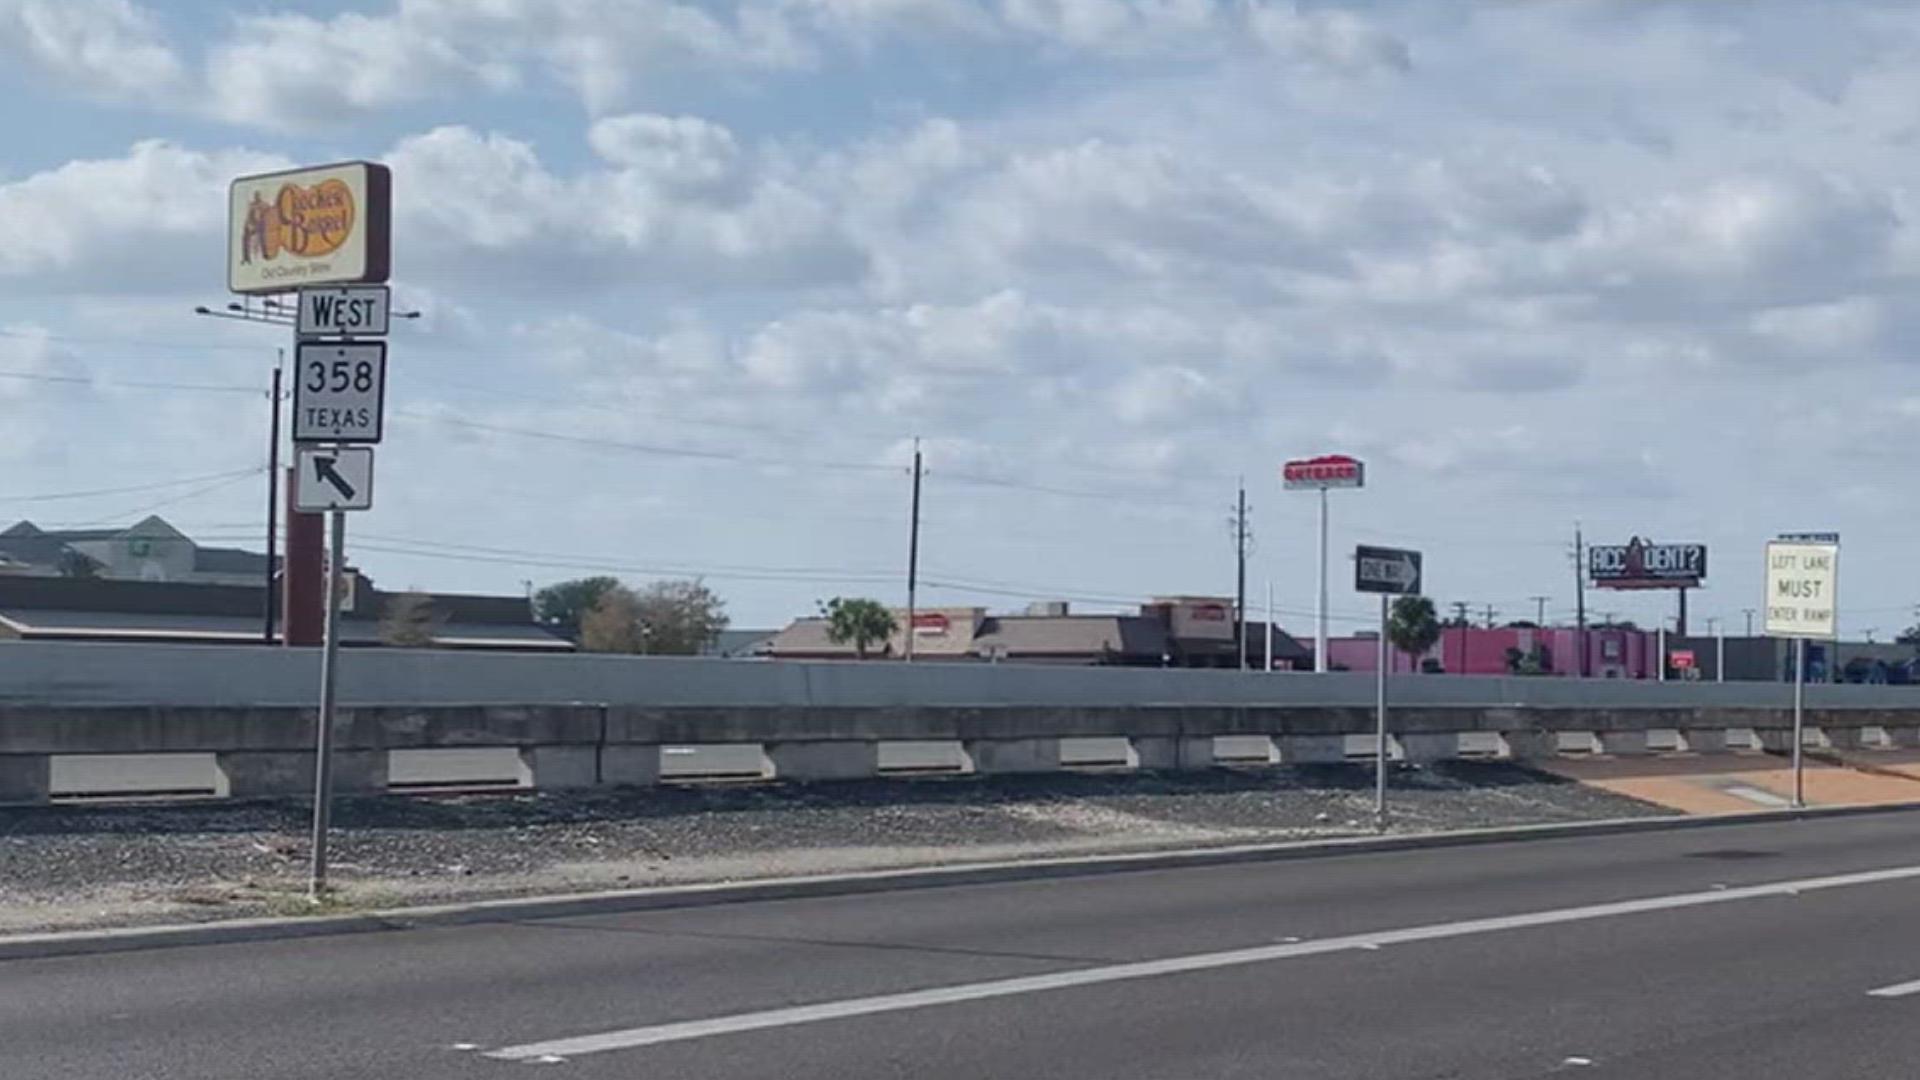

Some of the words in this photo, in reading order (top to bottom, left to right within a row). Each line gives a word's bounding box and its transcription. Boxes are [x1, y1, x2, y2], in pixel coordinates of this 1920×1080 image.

[312, 295, 376, 327] WEST
[306, 361, 373, 393] 358
[306, 407, 370, 428] TEXAS
[1592, 546, 1700, 570] ACCDENT?
[1771, 554, 1796, 570] LEFT
[1803, 555, 1831, 571] LANE
[1362, 560, 1381, 577] ONE
[1778, 579, 1822, 598] MUST
[1768, 606, 1797, 621] ENTER
[1803, 608, 1832, 622] RAMP
